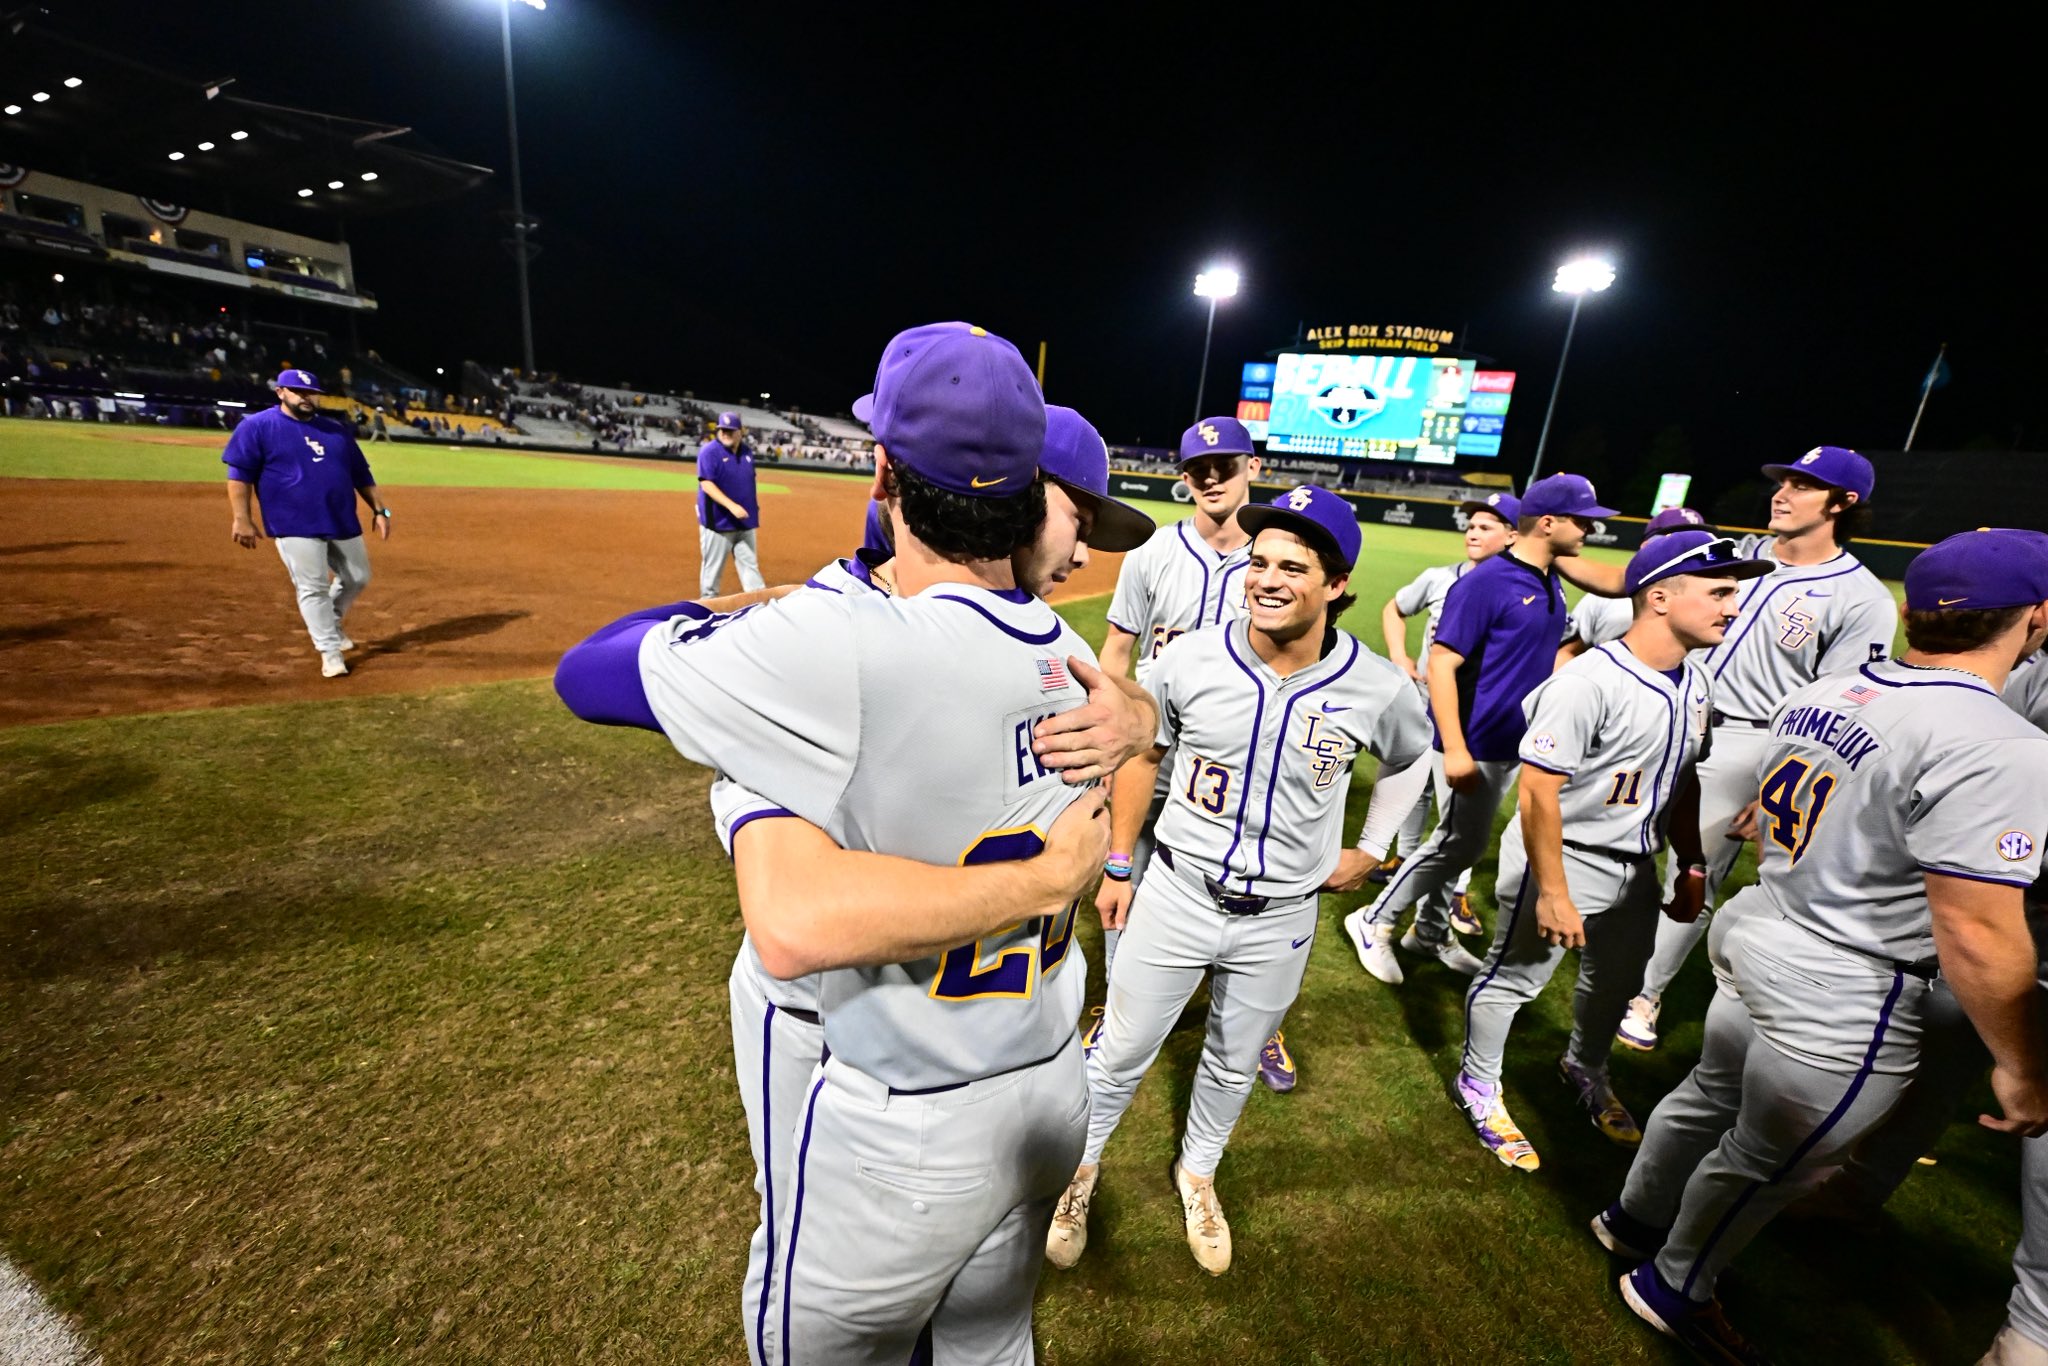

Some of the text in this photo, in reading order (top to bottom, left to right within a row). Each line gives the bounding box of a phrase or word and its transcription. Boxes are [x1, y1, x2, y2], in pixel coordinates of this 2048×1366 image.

[1307, 325, 1454, 344] ALEX BOX STADIUM
[1319, 338, 1439, 353] SKIP BERTMAN FIELD
[1198, 422, 1220, 447] LSU
[1281, 459, 1339, 473] LANDING
[1288, 485, 1313, 512] LSU
[1779, 596, 1815, 649] LSU
[1301, 714, 1344, 790] LSU
[1185, 755, 1231, 816] 13
[1605, 769, 1644, 806] 11
[1760, 755, 1837, 870] 41
[1998, 831, 2033, 860] SEC
